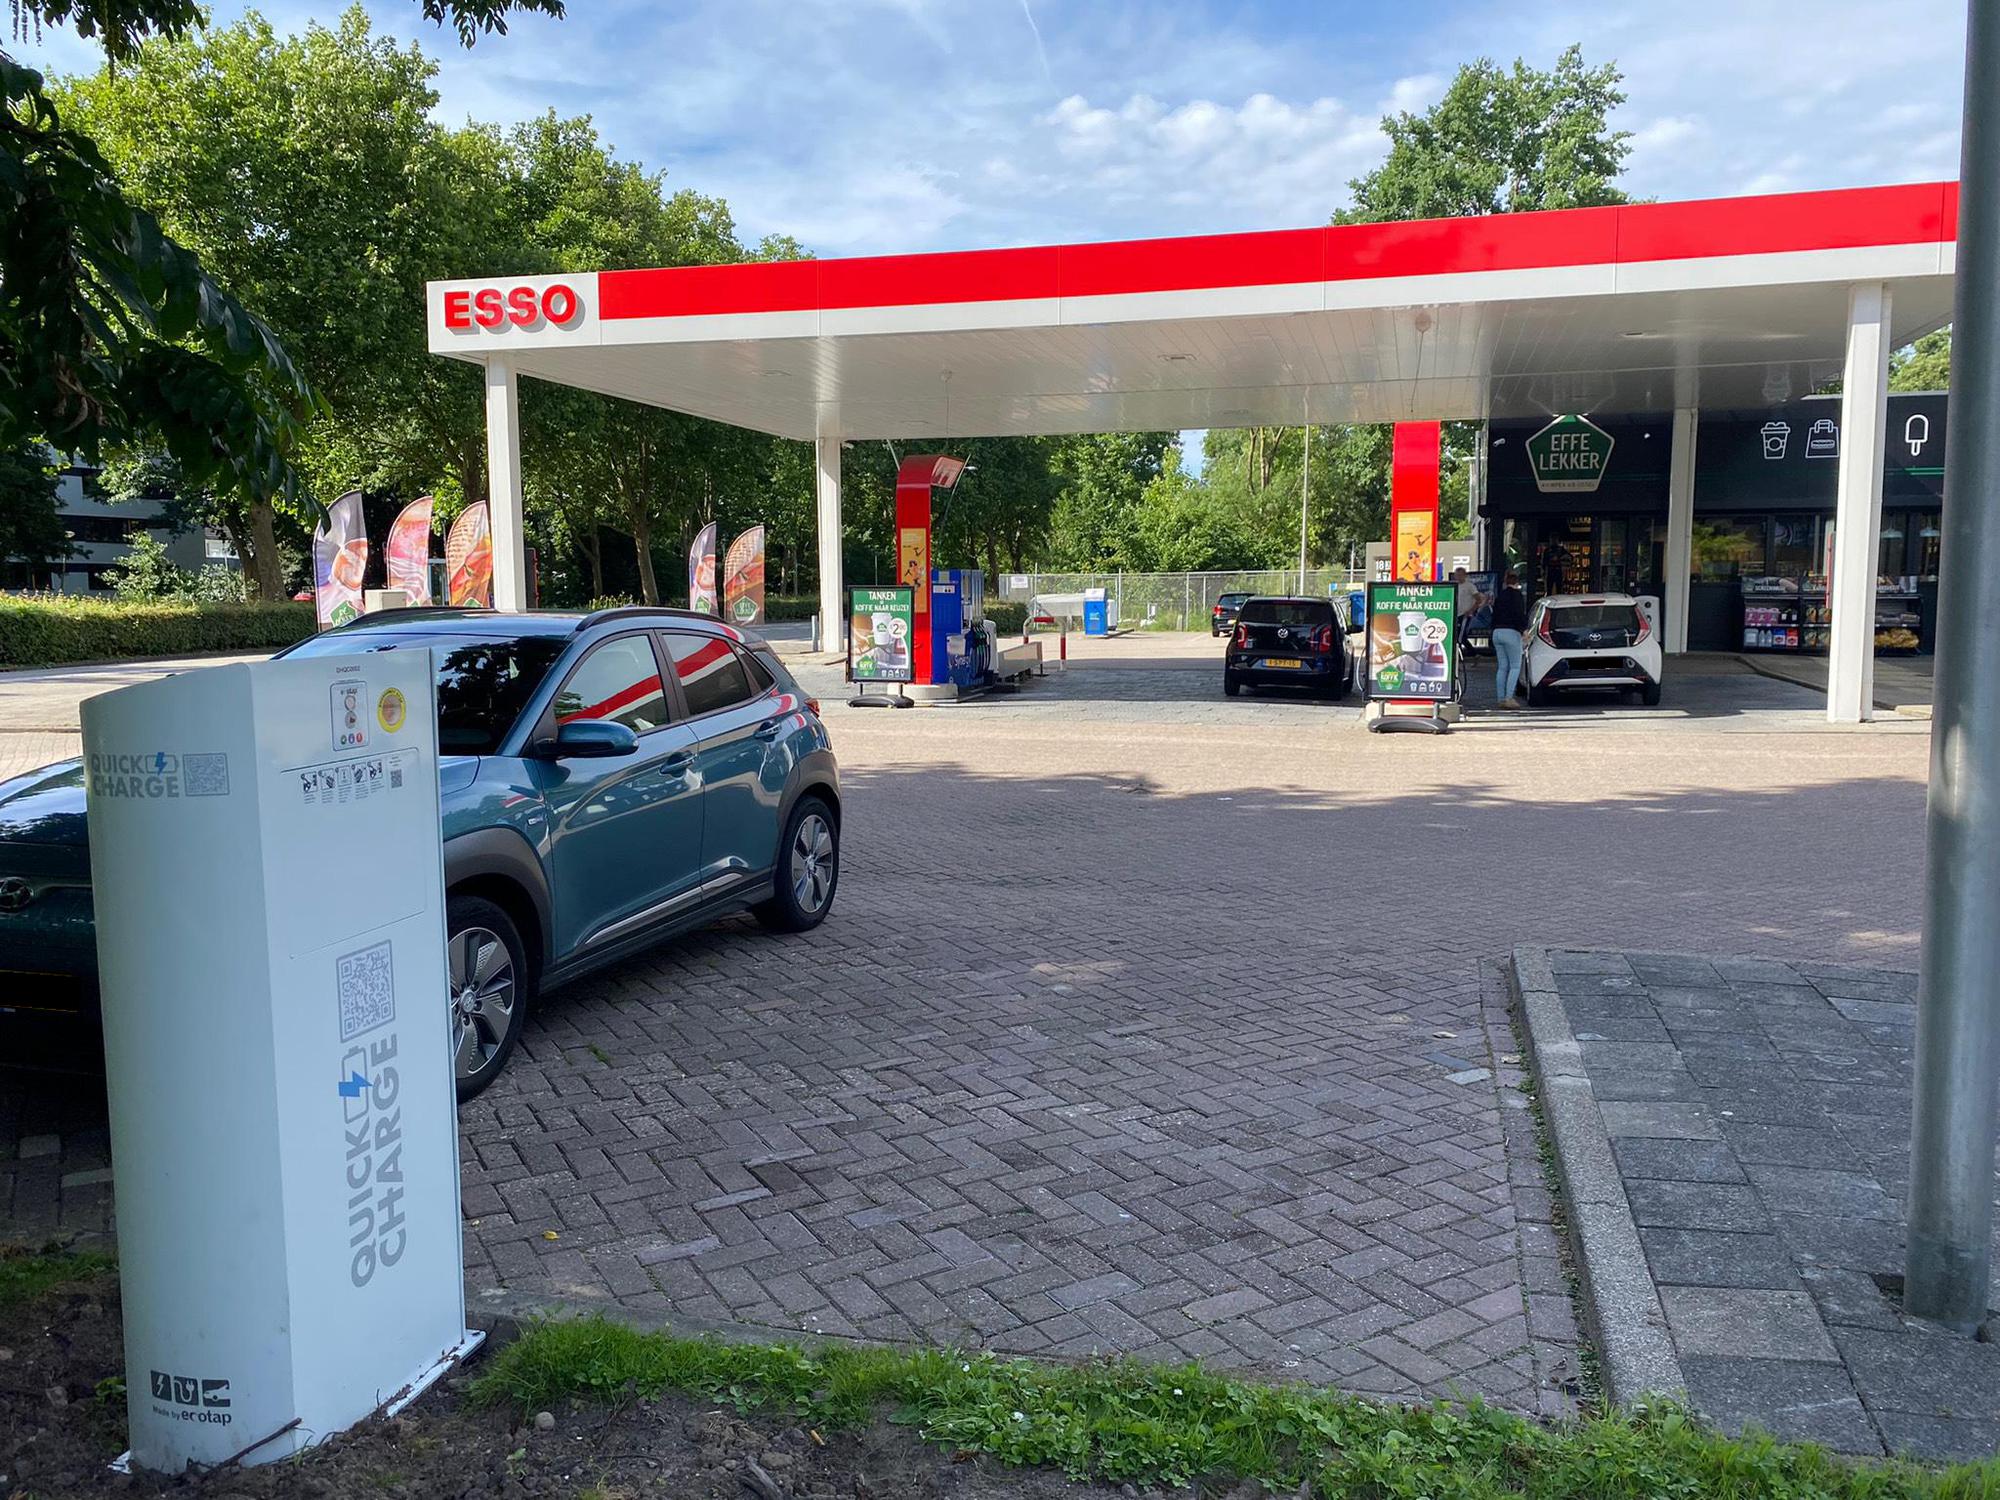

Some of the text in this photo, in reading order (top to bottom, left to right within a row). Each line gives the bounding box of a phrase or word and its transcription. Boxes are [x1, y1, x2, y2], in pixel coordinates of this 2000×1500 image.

[444, 284, 578, 329] ESSO
[1551, 433, 1591, 451] EFFE
[1539, 452, 1600, 470] LEKKER
[868, 591, 897, 600] TANKEN
[1396, 586, 1433, 596] TANKEN
[1376, 602, 1402, 610] KOFFIE
[1402, 602, 1423, 610] NAAR
[91, 753, 145, 774] QUICK
[92, 775, 180, 798] CHARGE
[370, 1033, 407, 1268] CHARGE
[344, 1116, 377, 1289] QUICK
[152, 1405, 232, 1426] Made by ecotap
